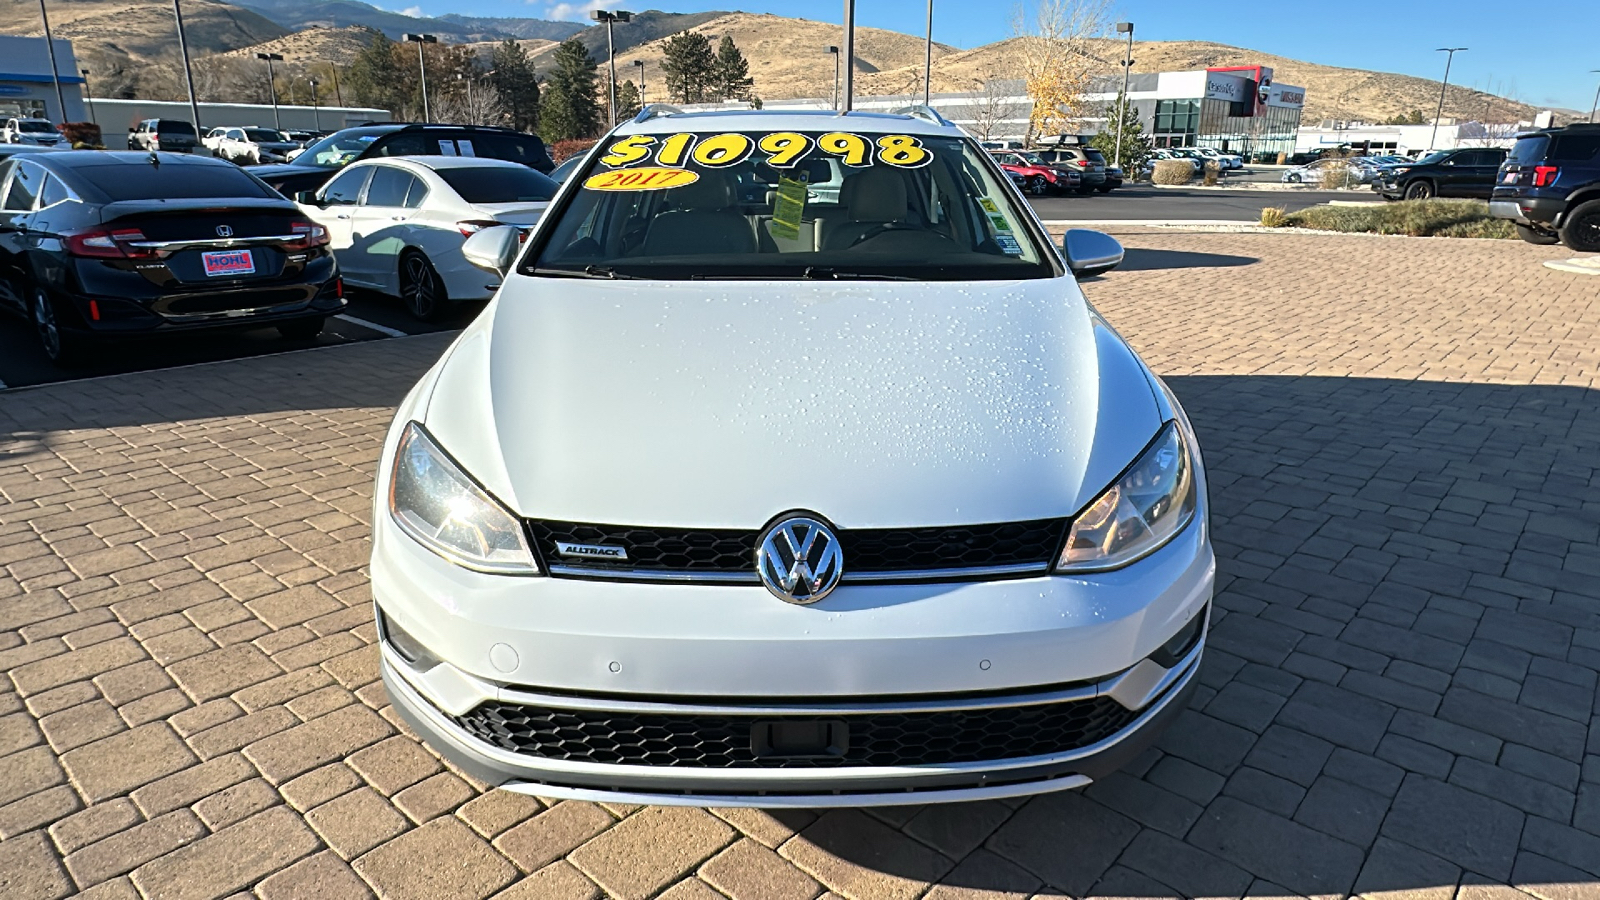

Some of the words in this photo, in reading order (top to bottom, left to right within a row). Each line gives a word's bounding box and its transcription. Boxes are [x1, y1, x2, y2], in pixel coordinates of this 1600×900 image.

[600, 132, 934, 168] $10998
[600, 171, 683, 188] 2017
[208, 256, 247, 266] HOHL
[565, 546, 620, 556] ALLTRACK
